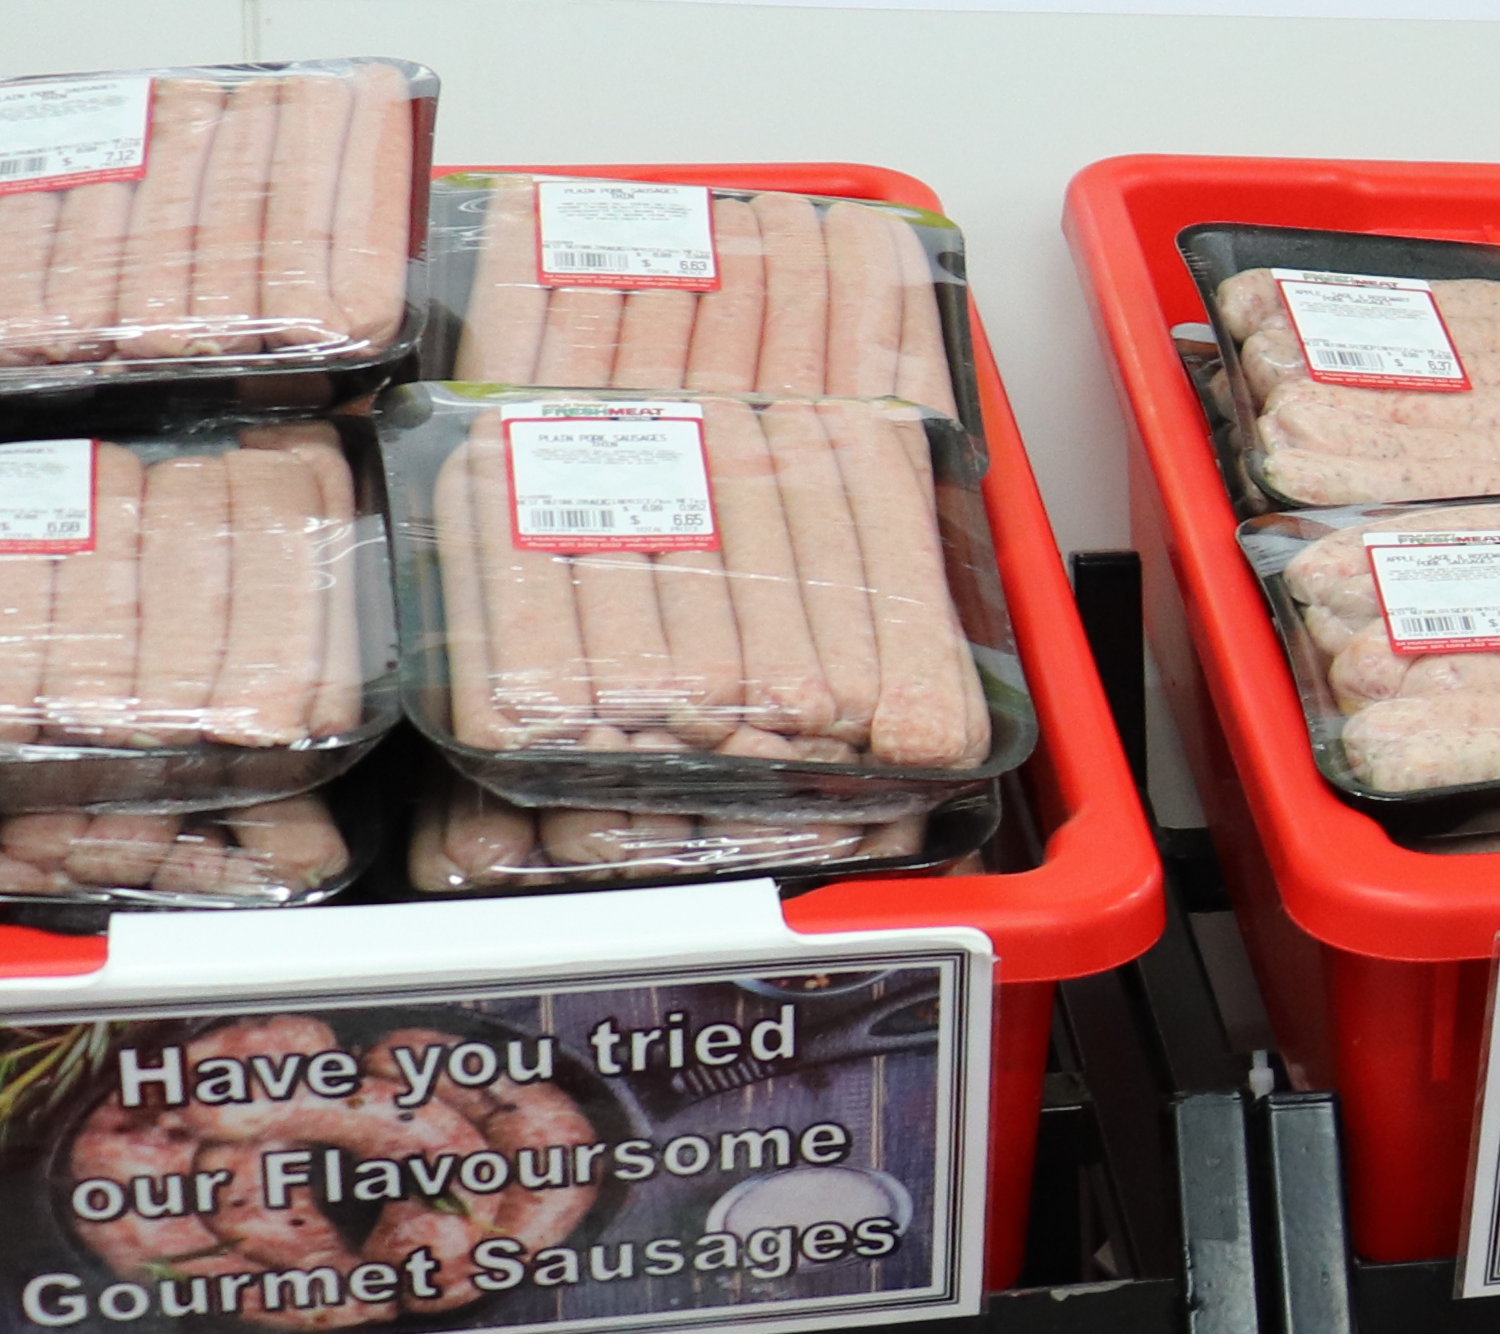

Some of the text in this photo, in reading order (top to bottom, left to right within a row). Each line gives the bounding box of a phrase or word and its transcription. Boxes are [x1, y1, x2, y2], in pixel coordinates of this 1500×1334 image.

[117, 1004, 799, 1111] Have you tried
[70, 1121, 853, 1223] our Flavoursome
[20, 1211, 904, 1328] Gourmet Sausages
